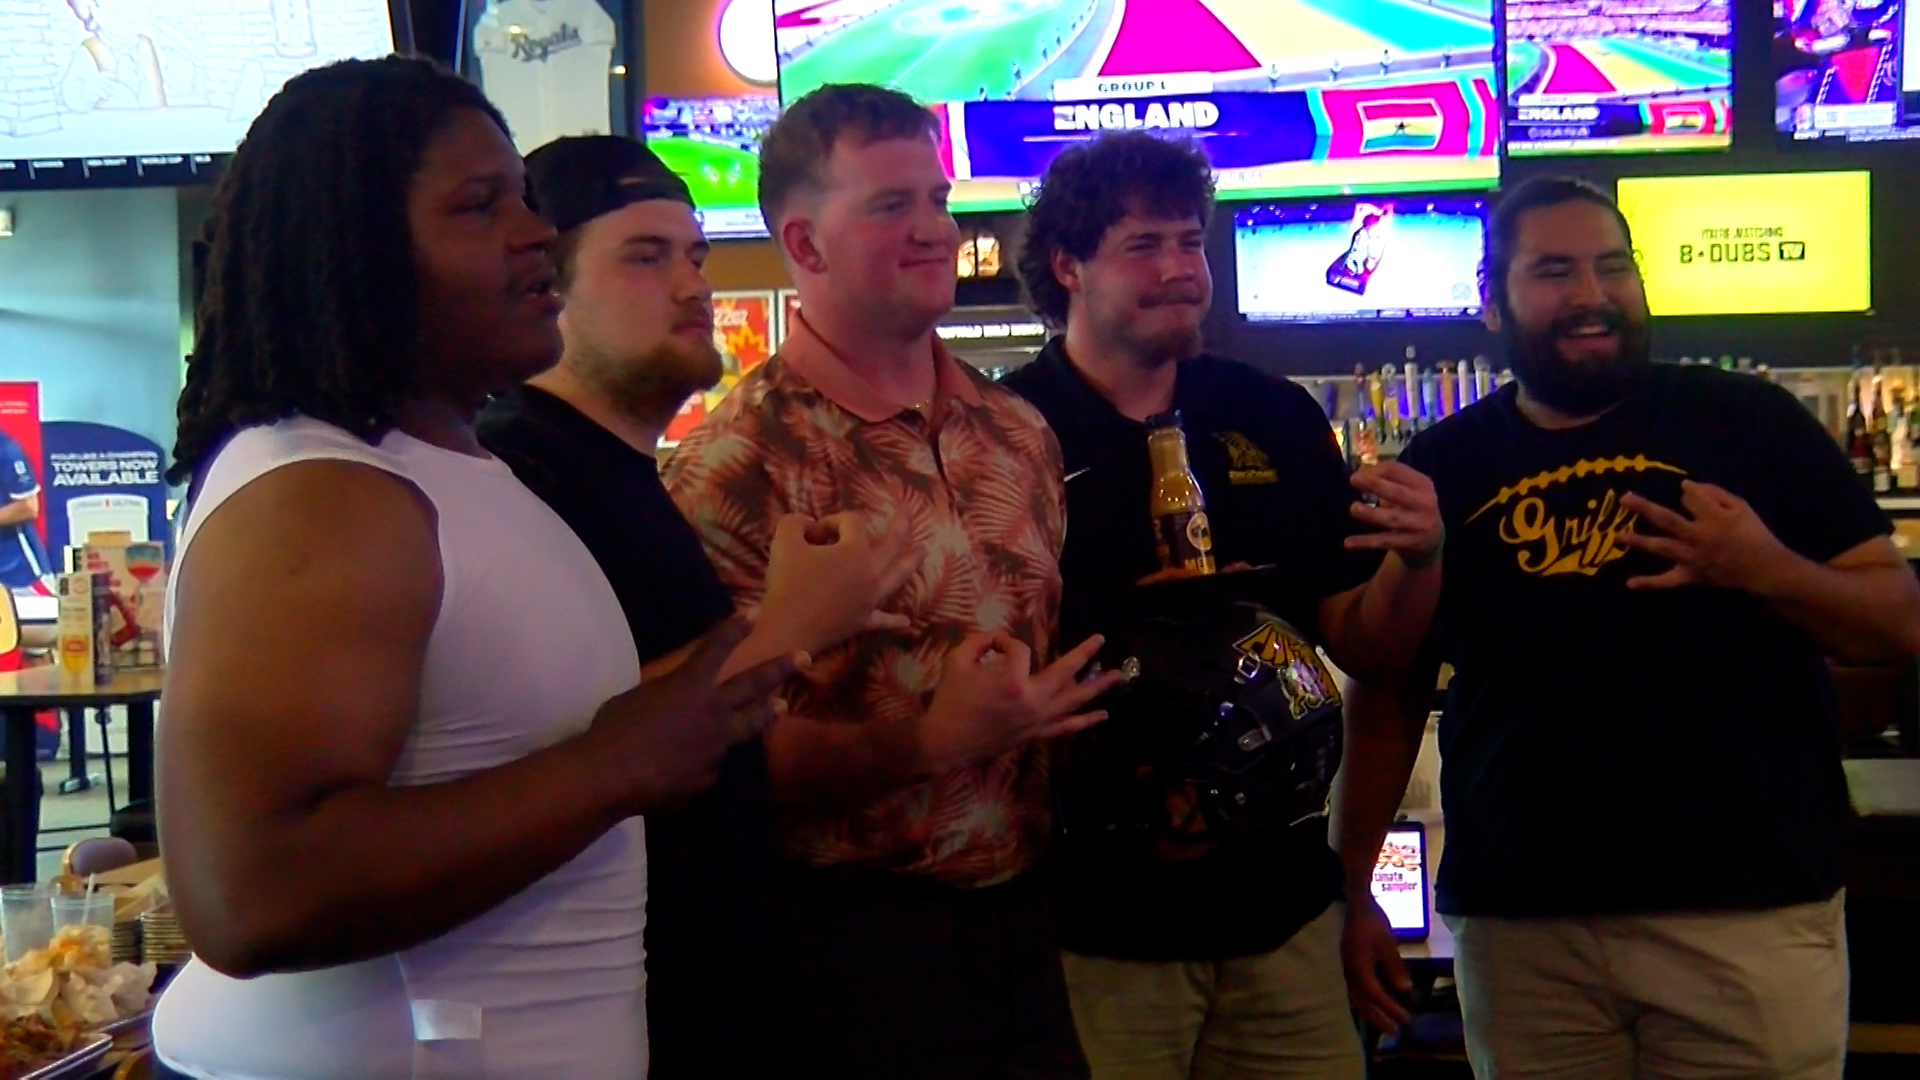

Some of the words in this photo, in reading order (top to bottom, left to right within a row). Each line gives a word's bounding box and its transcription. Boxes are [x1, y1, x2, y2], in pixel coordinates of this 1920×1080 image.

[509, 22, 583, 62] Royals
[1097, 80, 1156, 93] GROUP
[1052, 101, 1220, 131] ENGLAND
[1517, 106, 1601, 121] ENGLAND
[51, 461, 118, 473] TOWERS
[120, 459, 159, 471] NOW
[53, 470, 160, 486] AVAILABLE
[1381, 882, 1418, 893] sampler
